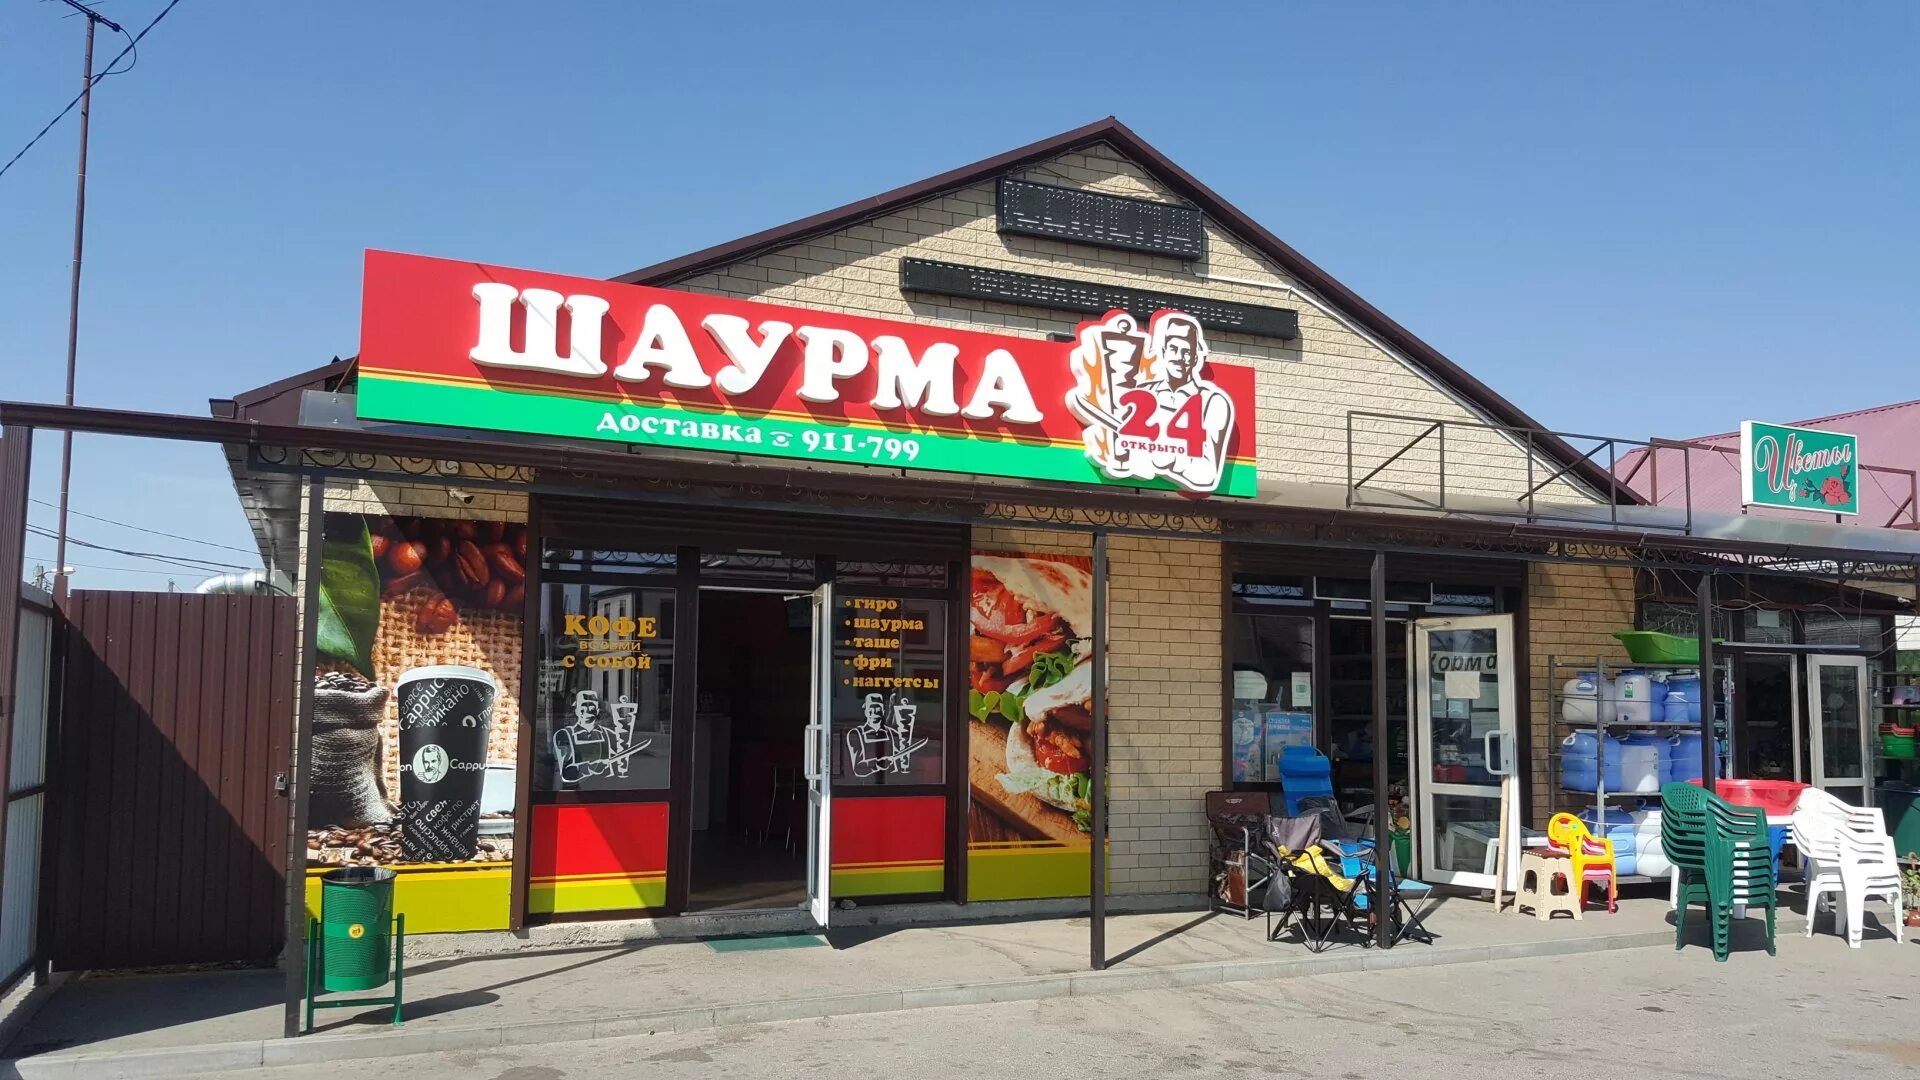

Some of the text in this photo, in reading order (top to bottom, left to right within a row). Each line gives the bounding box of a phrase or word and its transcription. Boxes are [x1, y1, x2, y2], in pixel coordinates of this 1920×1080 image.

[469, 282, 1044, 424] ШАУРМА
[1119, 389, 1207, 458] 24
[802, 430, 920, 461] 911-799
[1121, 440, 1185, 454] открыто
[1754, 432, 1852, 503] Цветы
[854, 598, 898, 613] гиро
[564, 614, 656, 638] КОФЕ
[853, 618, 924, 632] шаурма
[853, 637, 900, 649] таше
[584, 653, 652, 669] СОБОЙ
[853, 654, 893, 671] фри
[852, 677, 939, 689] наггетсы
[400, 678, 449, 730] Cappuc
